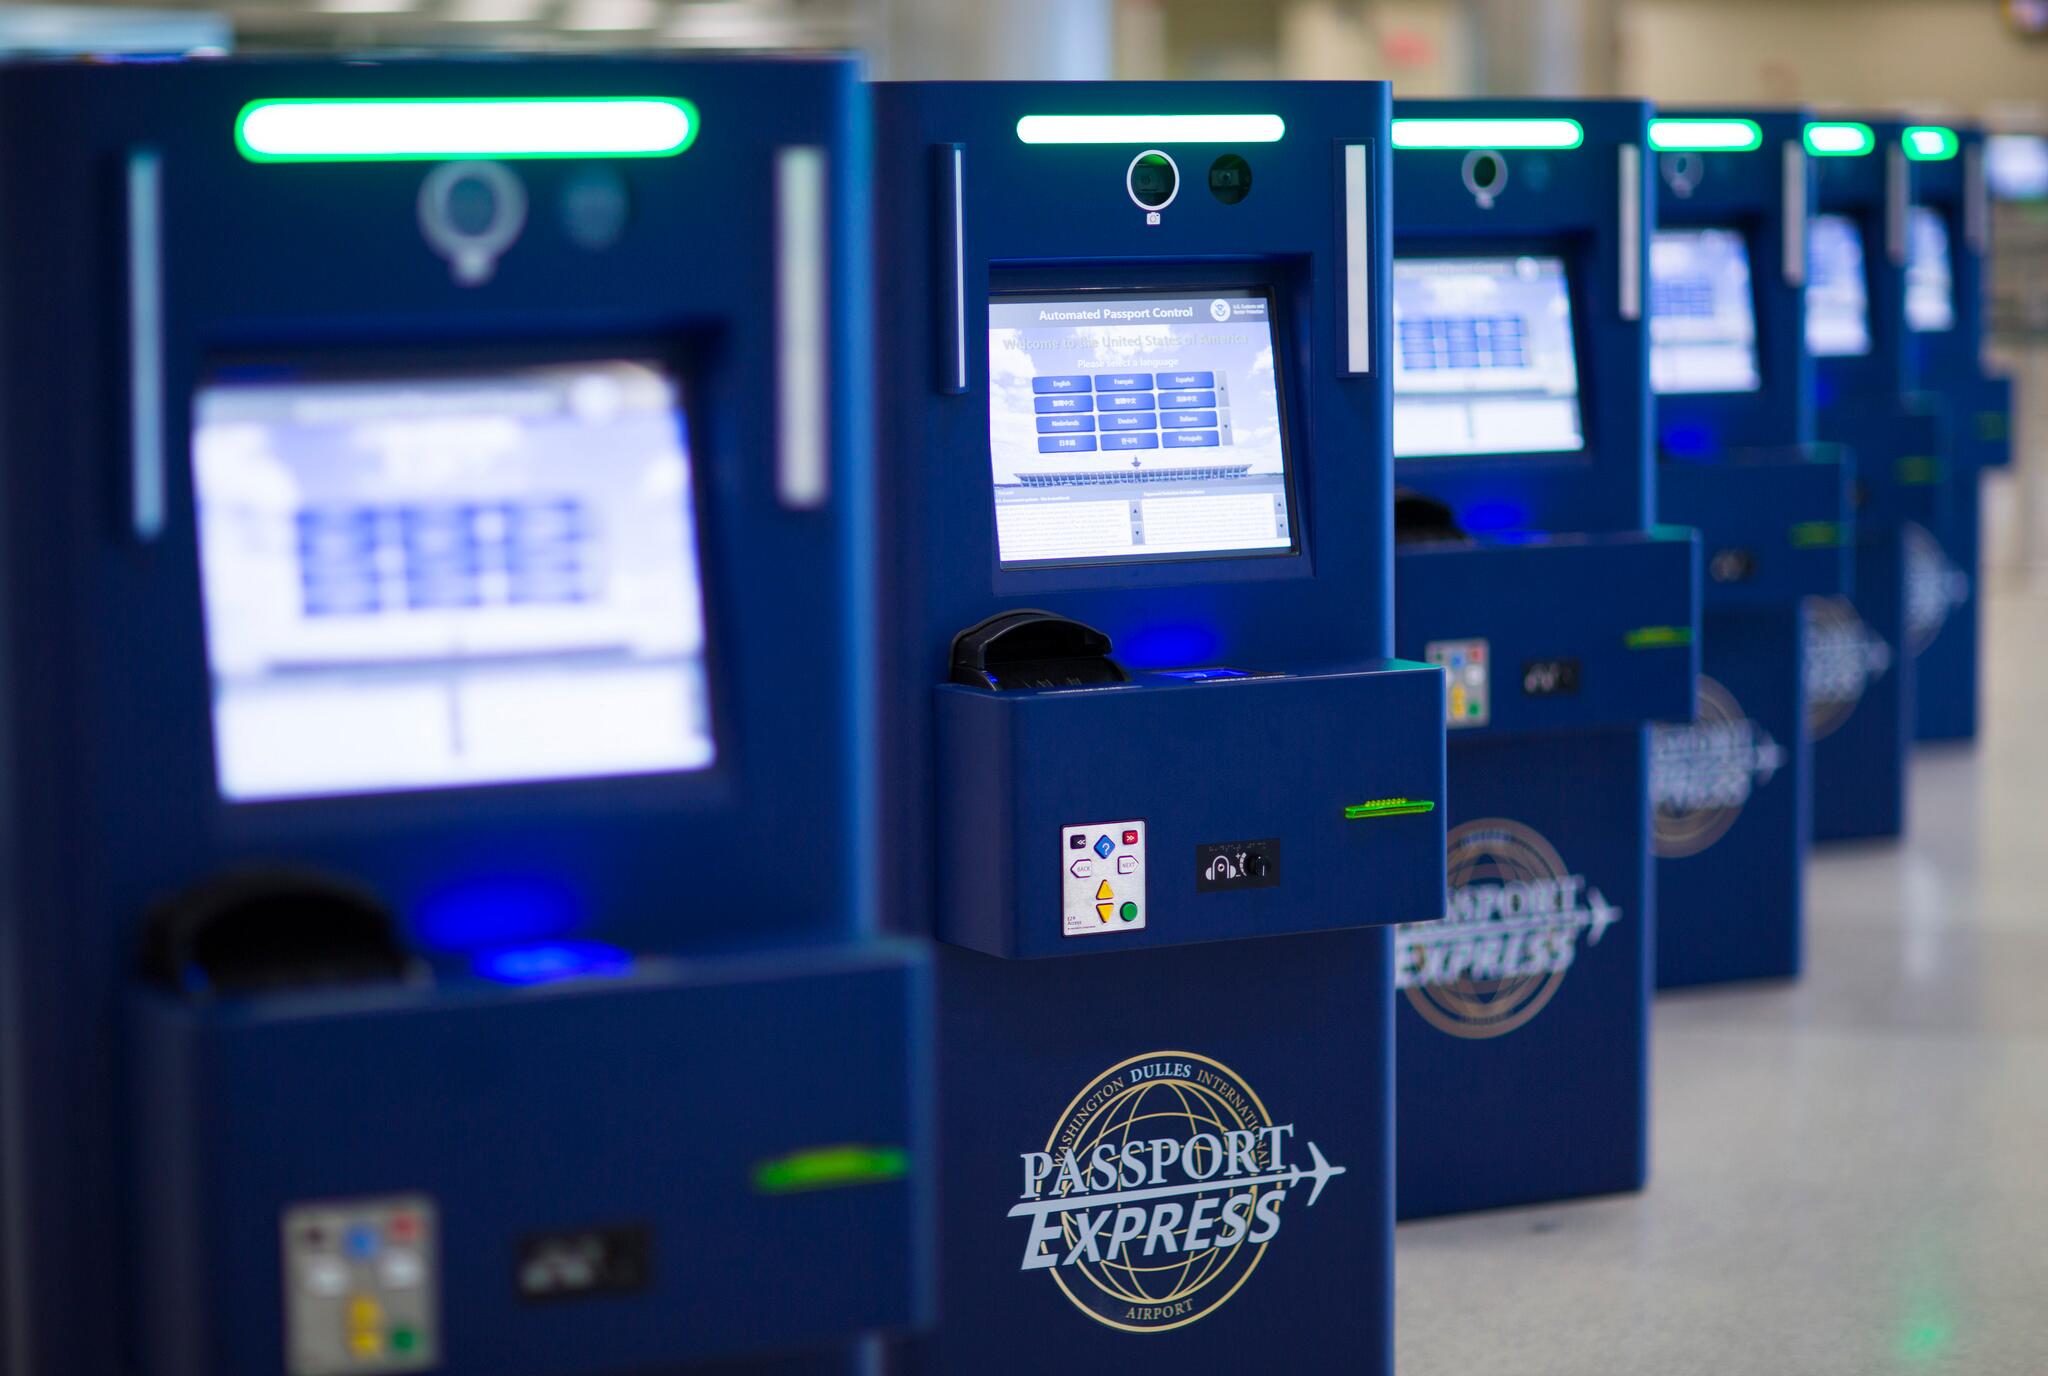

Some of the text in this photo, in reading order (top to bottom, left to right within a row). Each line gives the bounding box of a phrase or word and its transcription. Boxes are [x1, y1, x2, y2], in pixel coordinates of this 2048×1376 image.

[1039, 306, 1193, 321] Automated Passport Control
[1003, 338, 1060, 351] Welcome
[1064, 338, 1077, 349] to
[1081, 336, 1099, 349] the
[1102, 335, 1142, 348] United
[1145, 335, 1182, 347] States
[1078, 358, 1103, 369] Please
[1107, 358, 1129, 368] select
[1140, 357, 1180, 369] language
[1052, 1077, 1125, 1167] WASHINGTON
[1130, 1063, 1192, 1083] DULLES
[1020, 1124, 1294, 1199] PASSPORT
[1011, 1190, 1287, 1271] EXPRESS
[1126, 1299, 1194, 1320] AIRPORT
